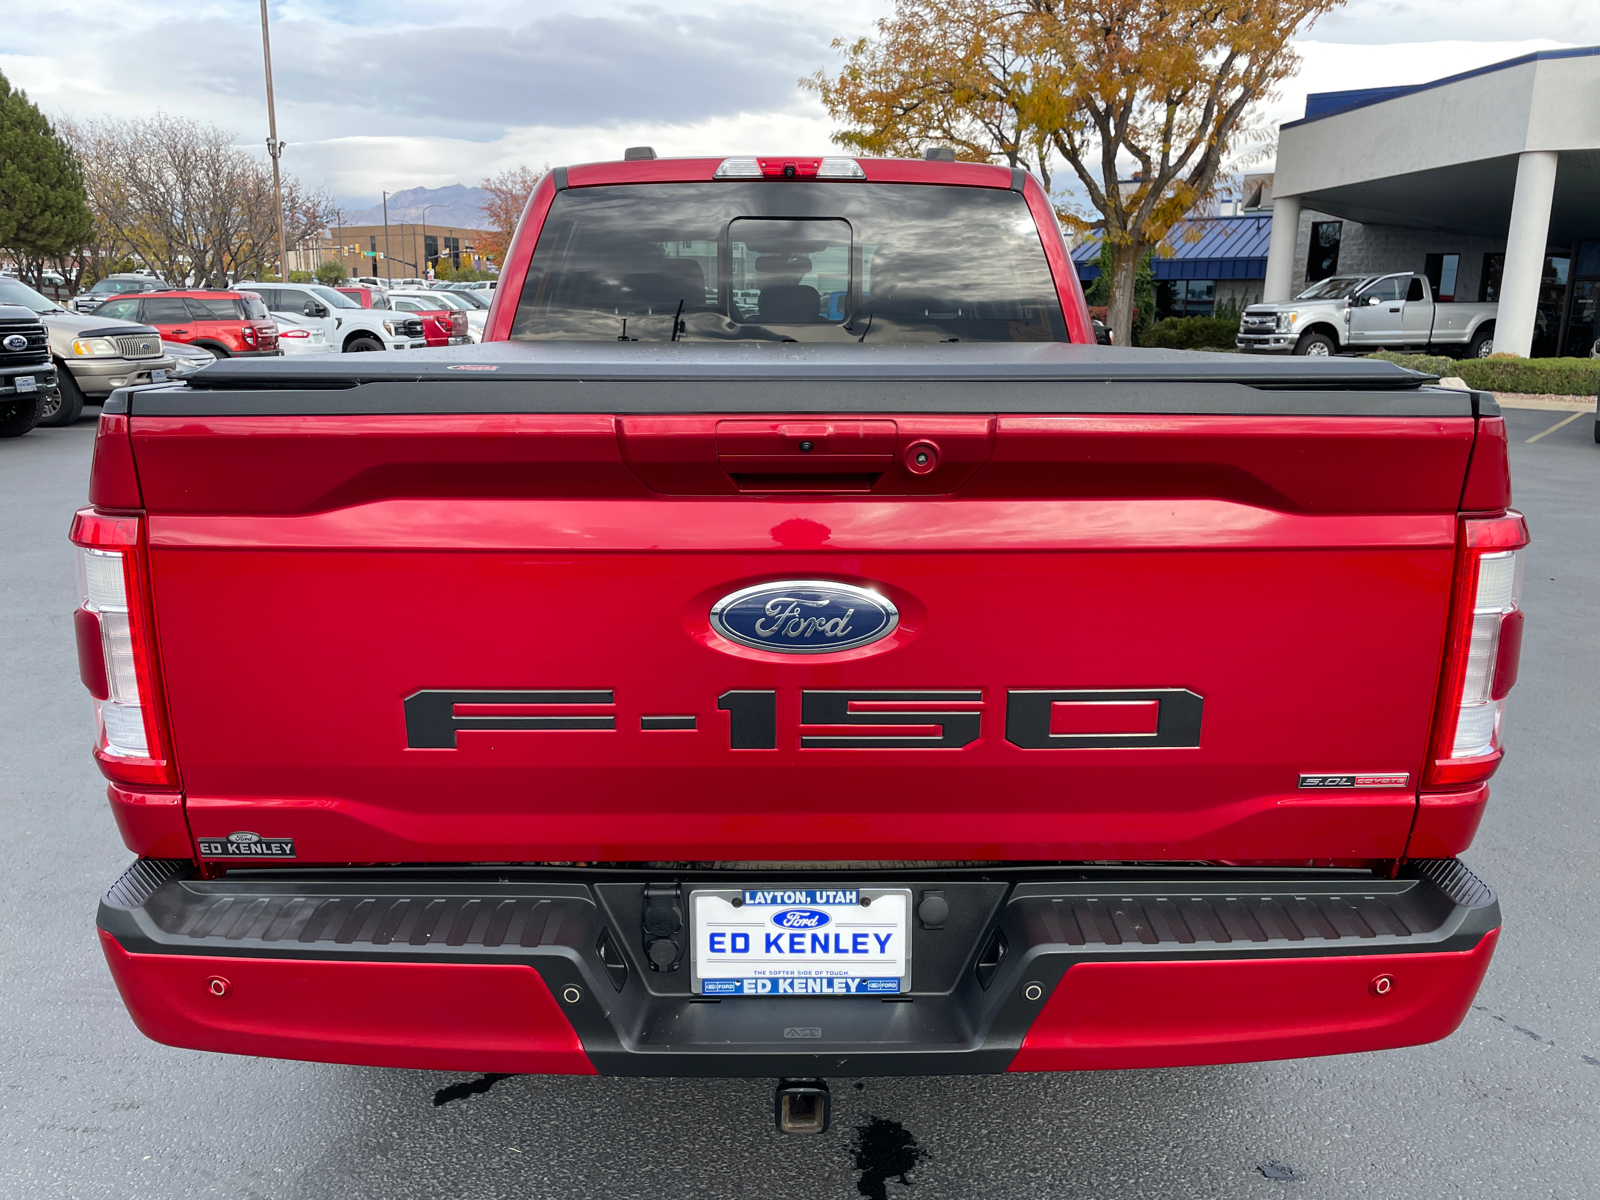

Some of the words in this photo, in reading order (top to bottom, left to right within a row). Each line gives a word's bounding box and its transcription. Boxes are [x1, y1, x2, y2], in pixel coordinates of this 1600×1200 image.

[754, 597, 855, 638] Ford
[404, 688, 1204, 750] F-150
[1302, 777, 1352, 786] 5.0L
[235, 834, 254, 842] Ford
[199, 843, 222, 854] ED
[227, 843, 293, 854] KENLEY
[745, 891, 811, 904] LAYTON,
[816, 890, 857, 904] UTAH
[782, 910, 820, 928] Ford
[709, 932, 750, 954] ED
[764, 932, 893, 954] KENLEY
[743, 979, 772, 994] ED
[778, 978, 861, 994] KENLEY
